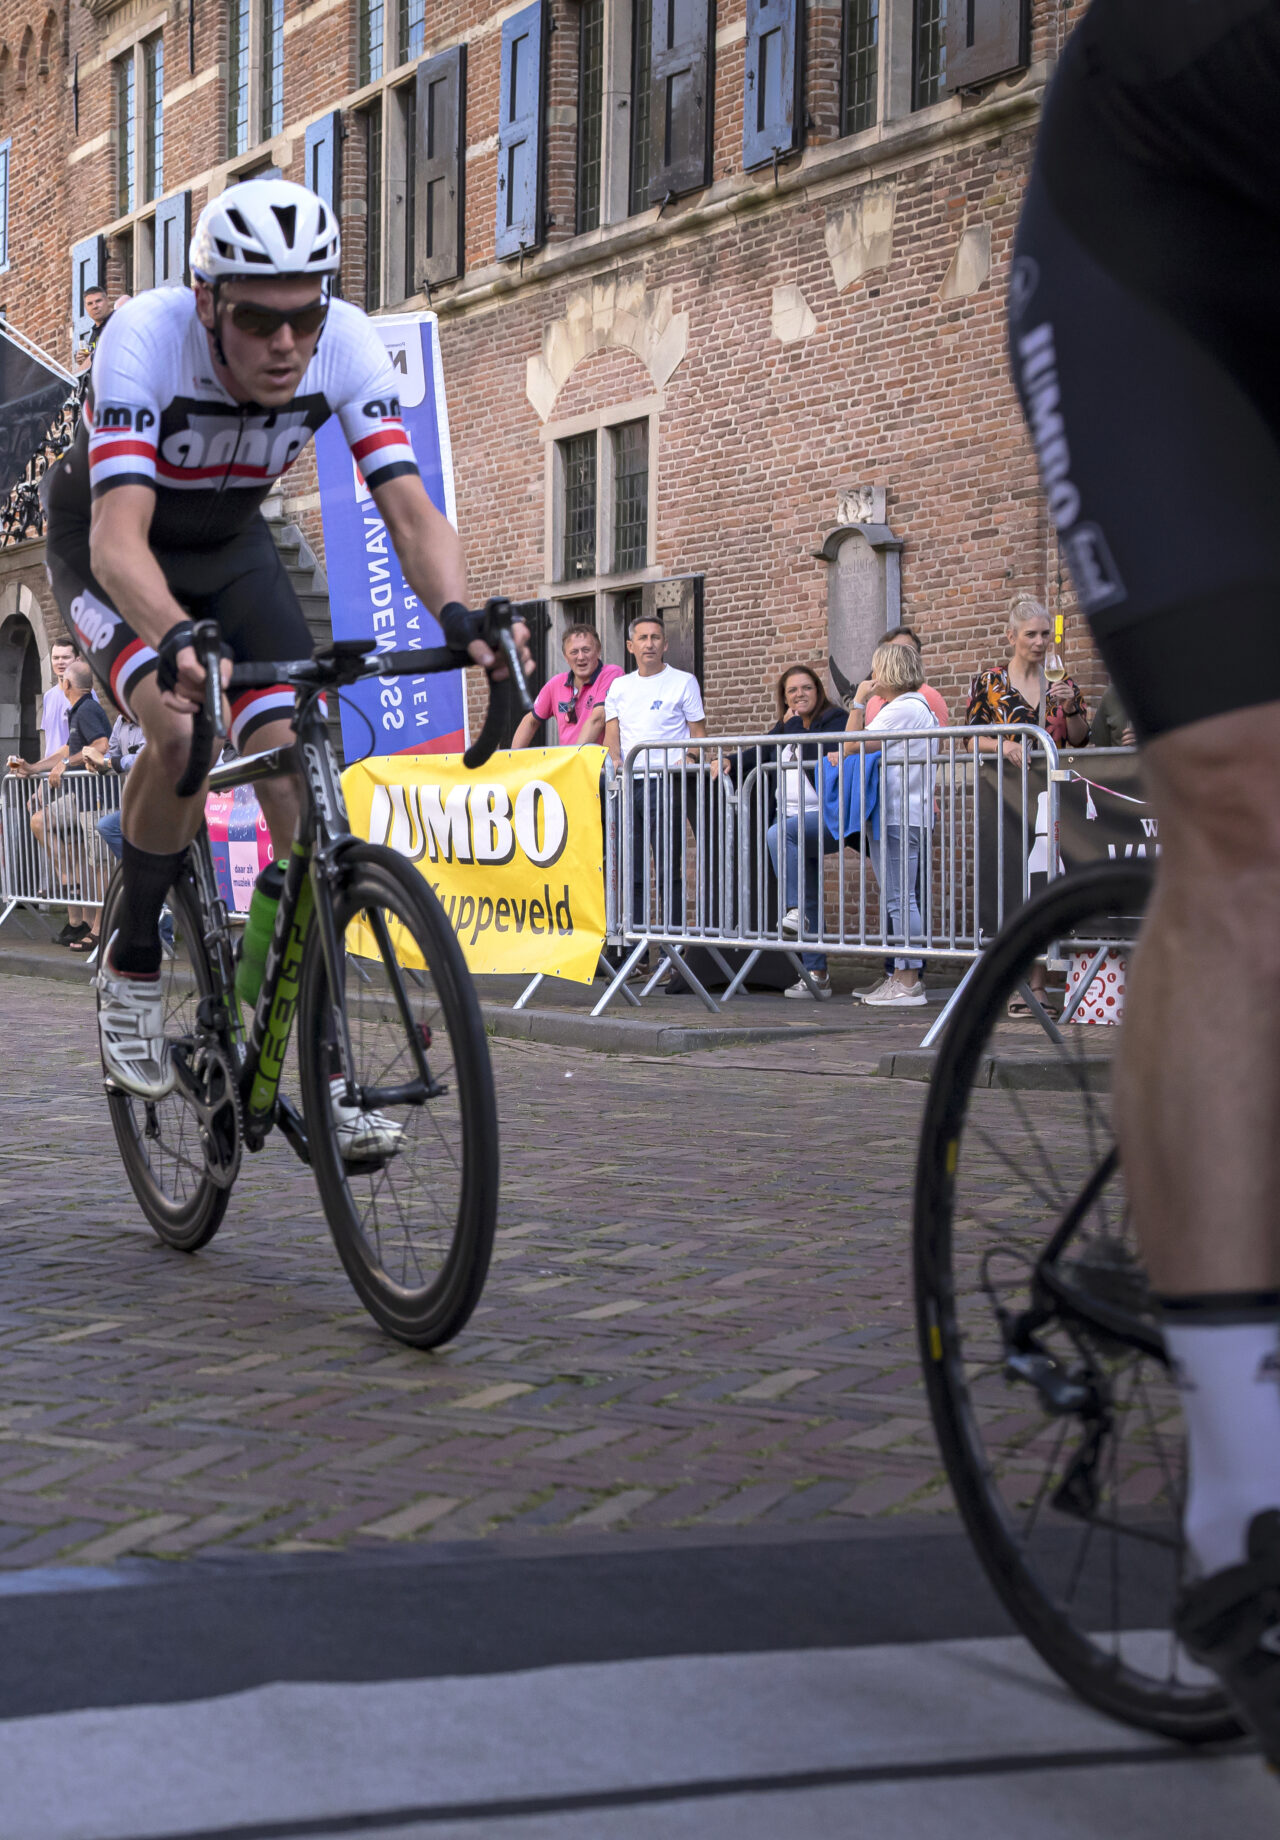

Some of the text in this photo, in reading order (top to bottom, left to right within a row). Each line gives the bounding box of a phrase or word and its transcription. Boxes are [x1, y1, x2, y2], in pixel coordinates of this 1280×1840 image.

[71, 596, 115, 654] amp
[369, 780, 568, 867] JUMBO
[432, 882, 574, 945] uppeveld
